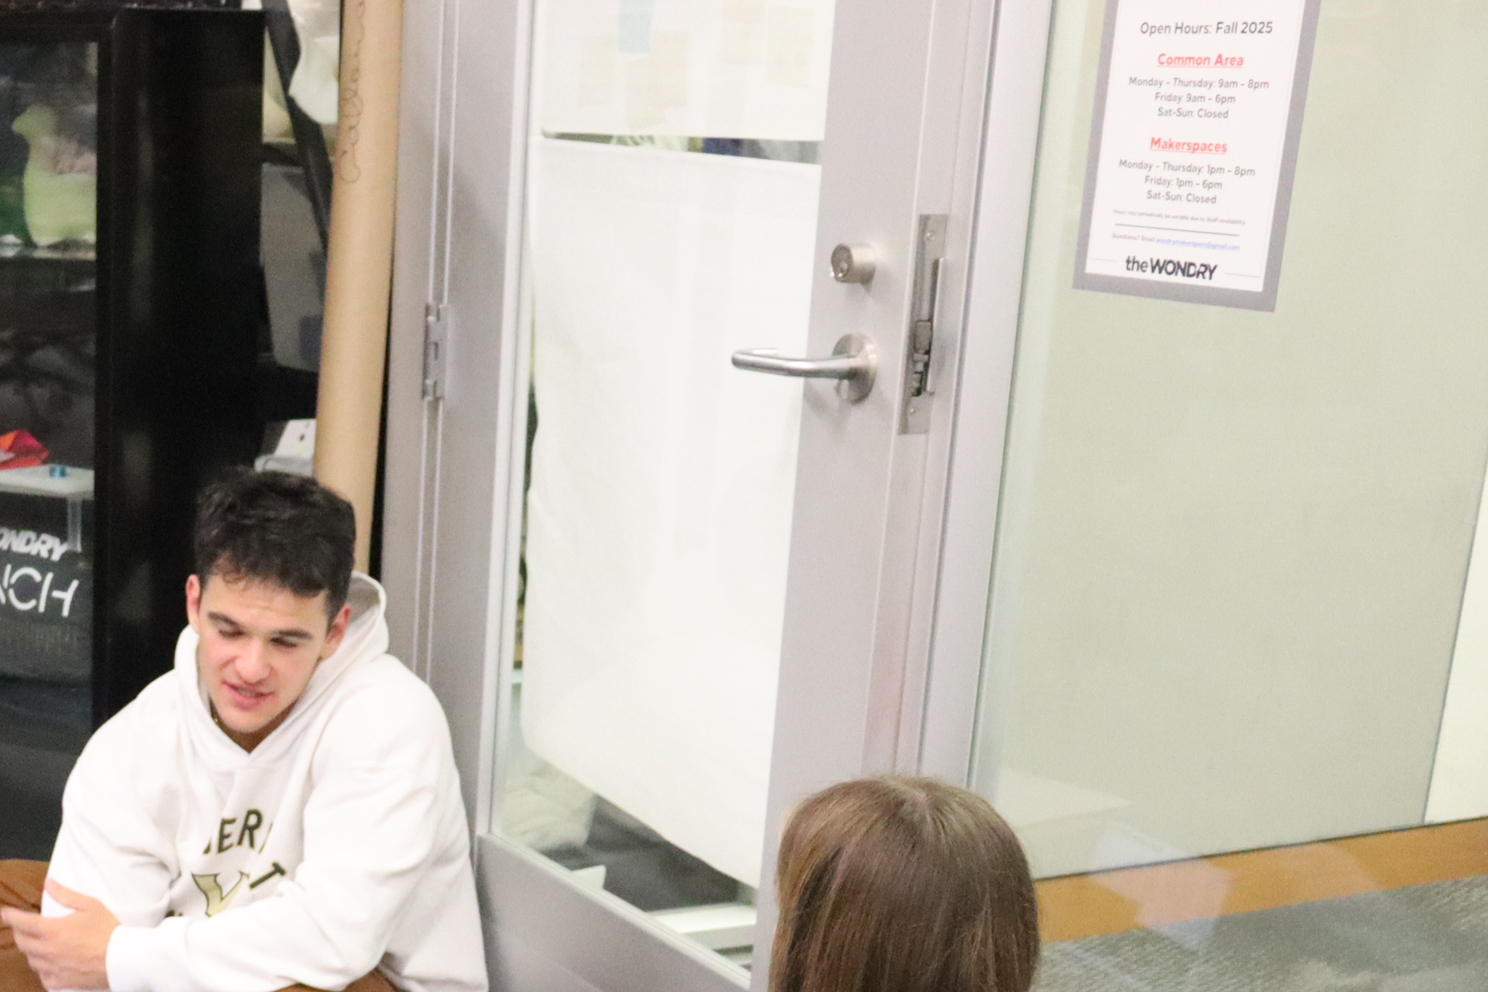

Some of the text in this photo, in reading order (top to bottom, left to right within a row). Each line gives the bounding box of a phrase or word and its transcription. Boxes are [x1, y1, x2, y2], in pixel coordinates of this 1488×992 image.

[1140, 21, 1273, 37] Open Hours: Fall 2025
[1157, 53, 1244, 67] Common Area
[1128, 77, 1163, 88] Monday
[1173, 77, 1215, 89] Thursday:
[1218, 80, 1238, 88] 9am
[1247, 79, 1270, 90] 8pm
[1155, 92, 1184, 104] Friday:
[1186, 93, 1205, 103] 9am
[1215, 94, 1236, 105] 6pm
[1157, 107, 1229, 119] Sat-Sun: Closed
[1150, 137, 1228, 154] Makerspaces
[1118, 159, 1153, 171] Monday
[1162, 161, 1205, 175] Thursday:
[1207, 164, 1225, 175] 1pm
[1234, 166, 1256, 177] 8pm
[1144, 175, 1174, 188] Friday:
[1176, 178, 1193, 188] 1pm
[1202, 179, 1223, 190] 6pm
[1147, 190, 1217, 204] Sat-Sun: Closed
